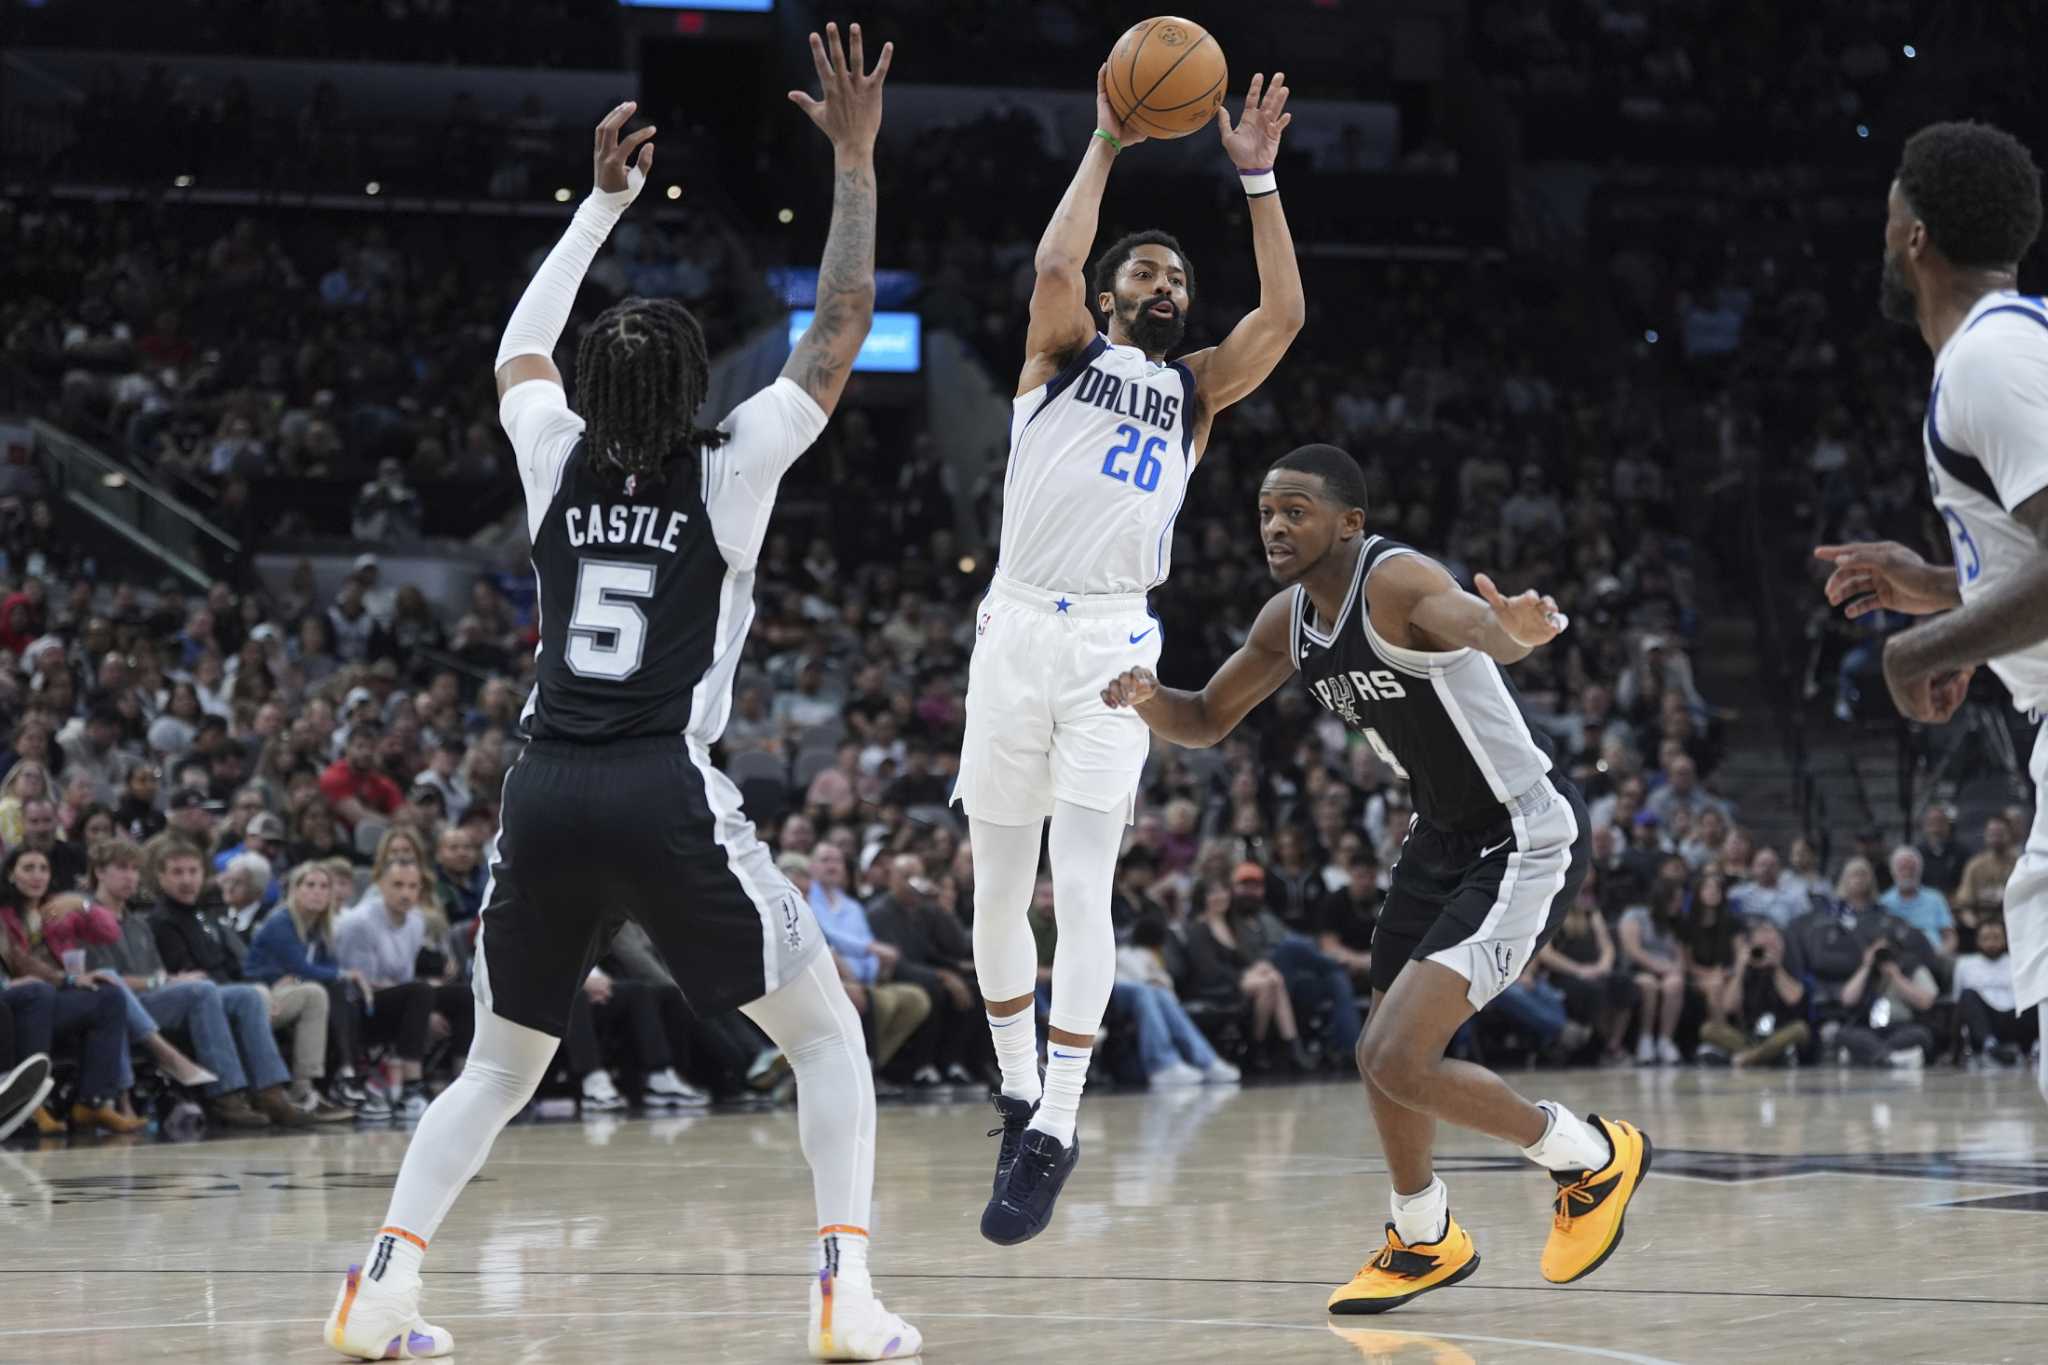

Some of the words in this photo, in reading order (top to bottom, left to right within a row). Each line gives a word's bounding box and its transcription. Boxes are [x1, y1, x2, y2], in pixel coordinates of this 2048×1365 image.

[1074, 365, 1179, 431] DALLAS
[1102, 423, 1168, 492] 26
[565, 504, 688, 553] CASTLE
[564, 557, 658, 681] 5
[1308, 670, 1406, 723] PURS
